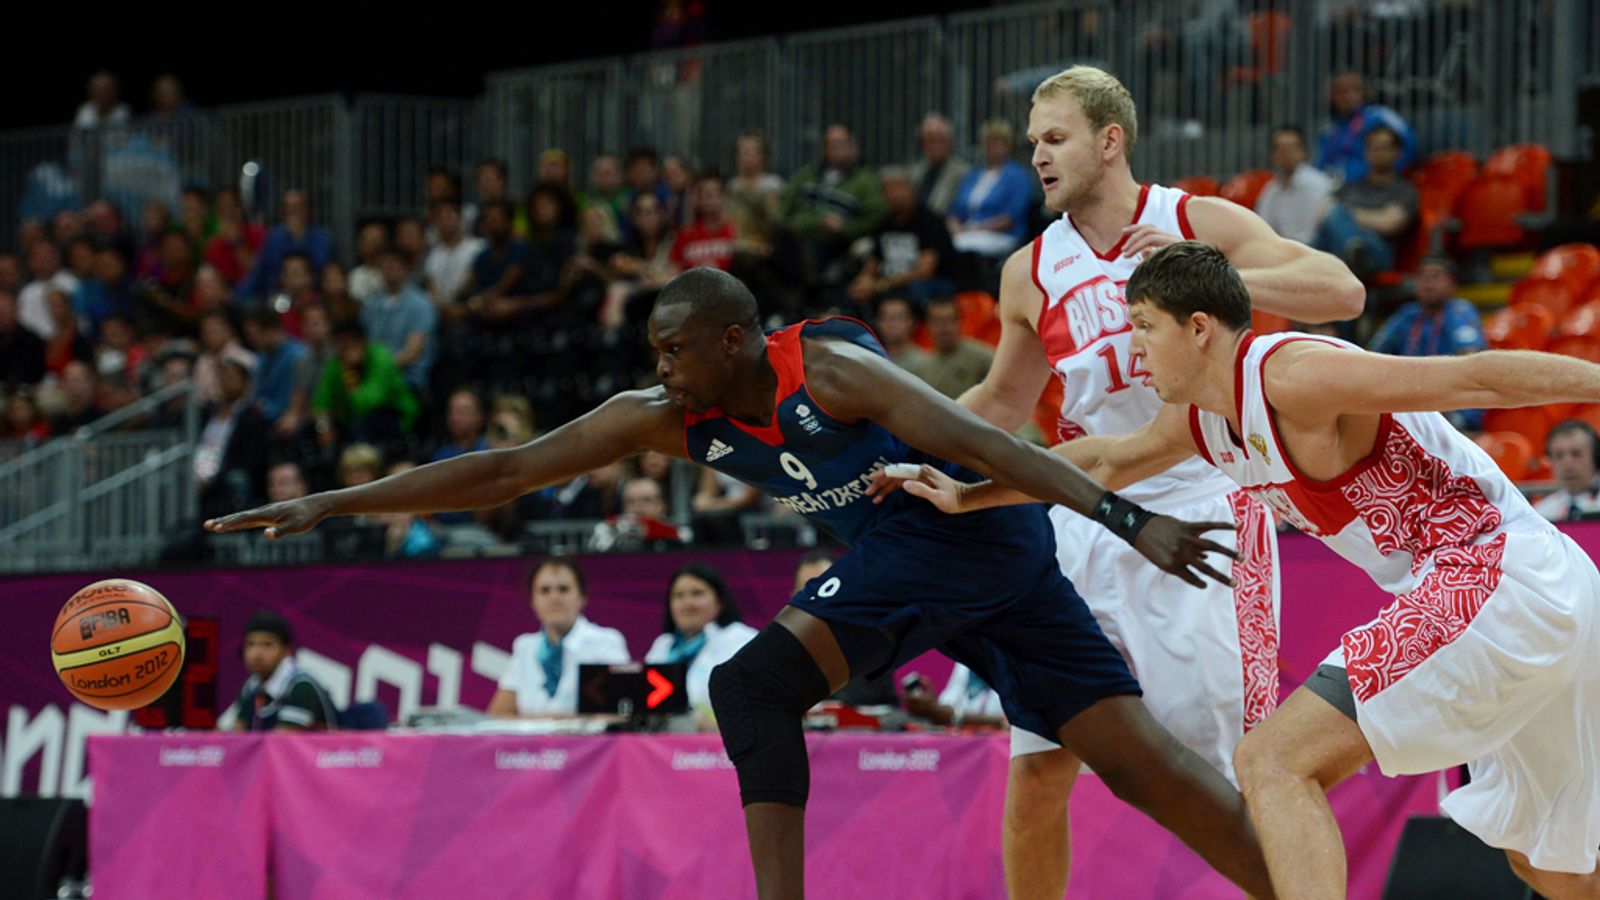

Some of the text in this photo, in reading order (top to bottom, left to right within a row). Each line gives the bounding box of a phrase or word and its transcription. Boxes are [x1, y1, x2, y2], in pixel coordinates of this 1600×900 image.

[1064, 281, 1133, 350] RUS
[779, 451, 818, 491] 9
[91, 607, 131, 632] FIBA
[70, 650, 169, 689] London 2012
